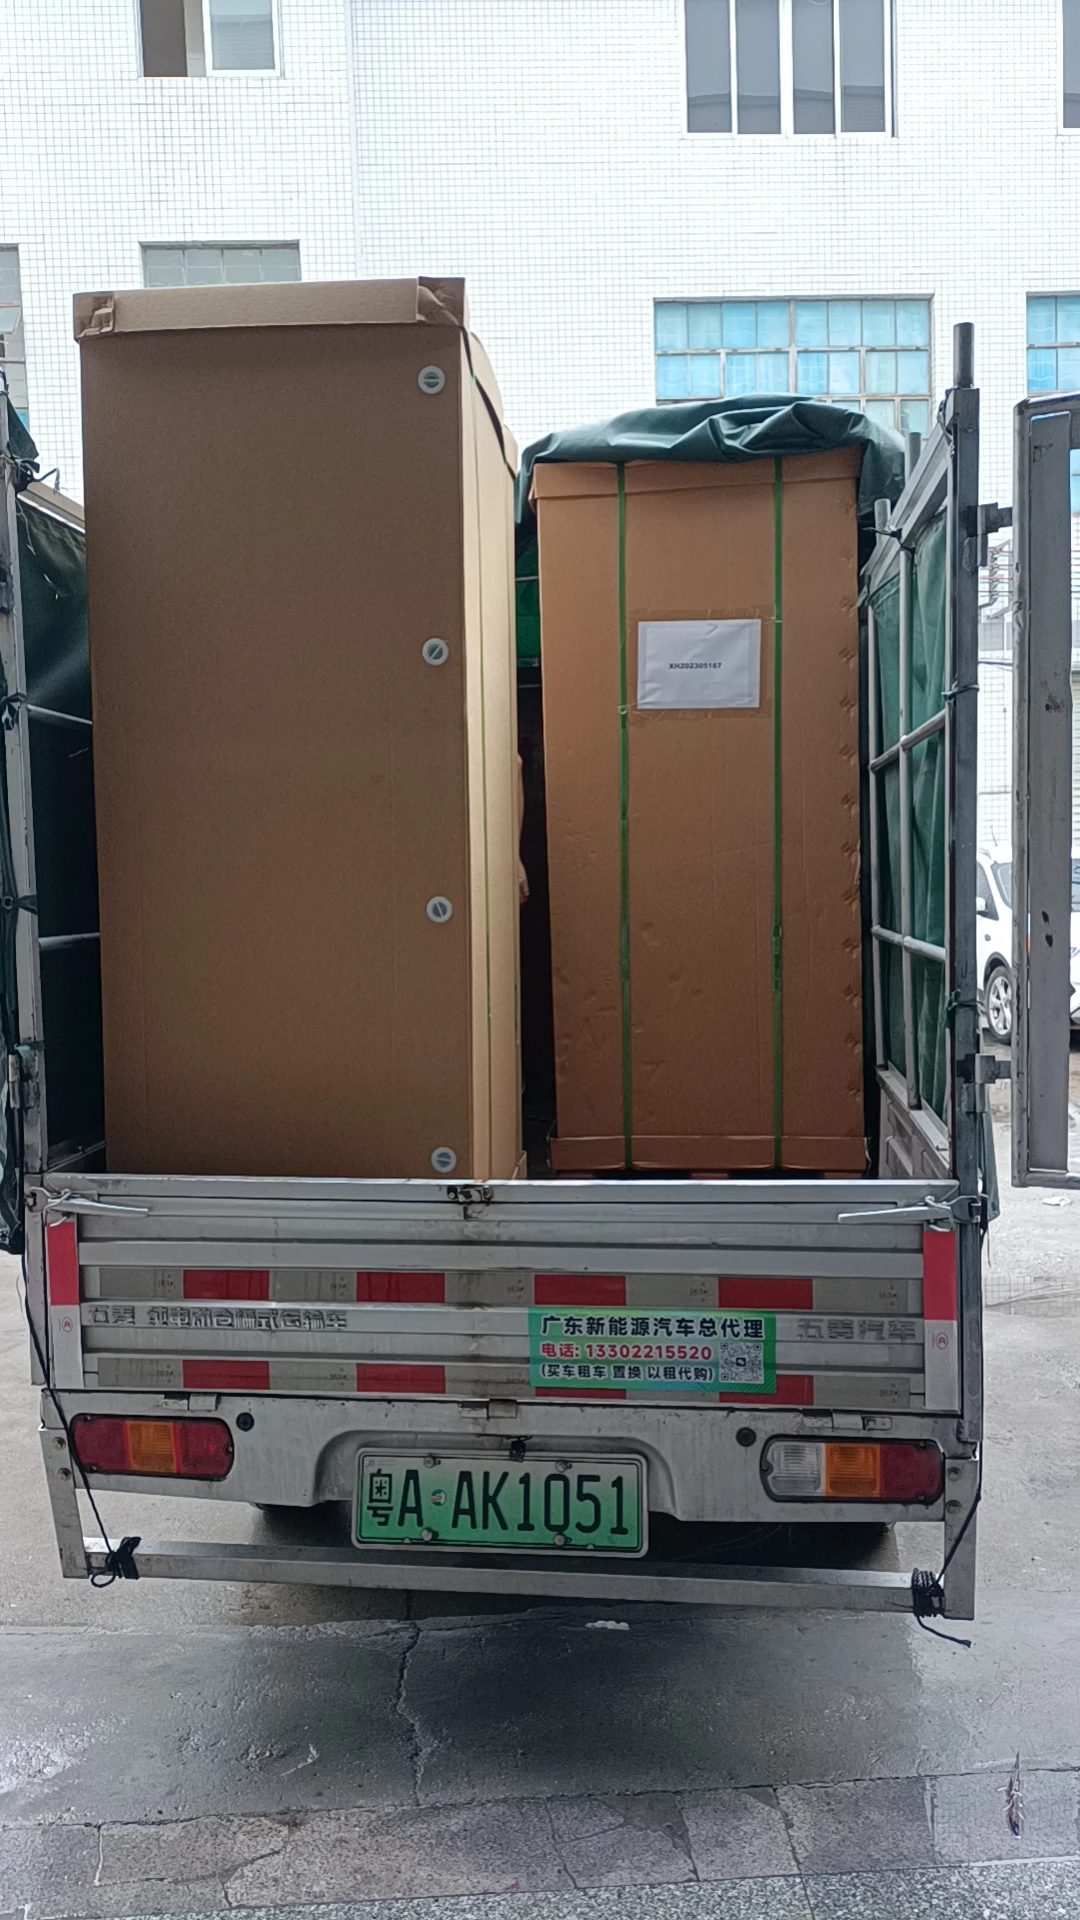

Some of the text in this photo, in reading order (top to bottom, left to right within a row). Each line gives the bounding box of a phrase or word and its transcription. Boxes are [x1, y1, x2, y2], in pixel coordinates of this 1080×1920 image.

[540, 1314, 765, 1339] 广东新能源汽车总代理
[585, 1343, 713, 1361] 13302215520
[540, 1363, 714, 1382] (买车租车 置换 以租代购)
